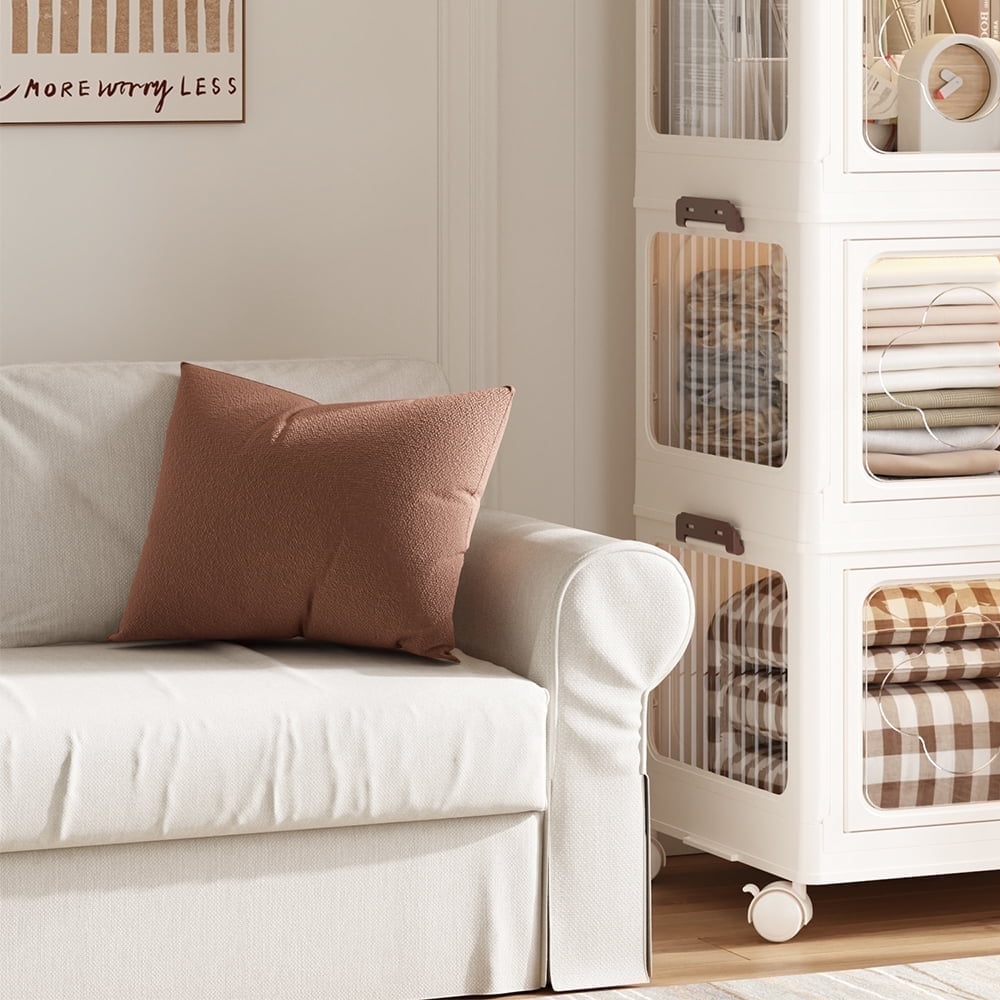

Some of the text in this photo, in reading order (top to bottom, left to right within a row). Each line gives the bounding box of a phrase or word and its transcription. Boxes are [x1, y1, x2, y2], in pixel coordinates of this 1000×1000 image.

[24, 78, 90, 99] MORE
[98, 78, 174, 114] worry
[180, 75, 237, 96] LESS
